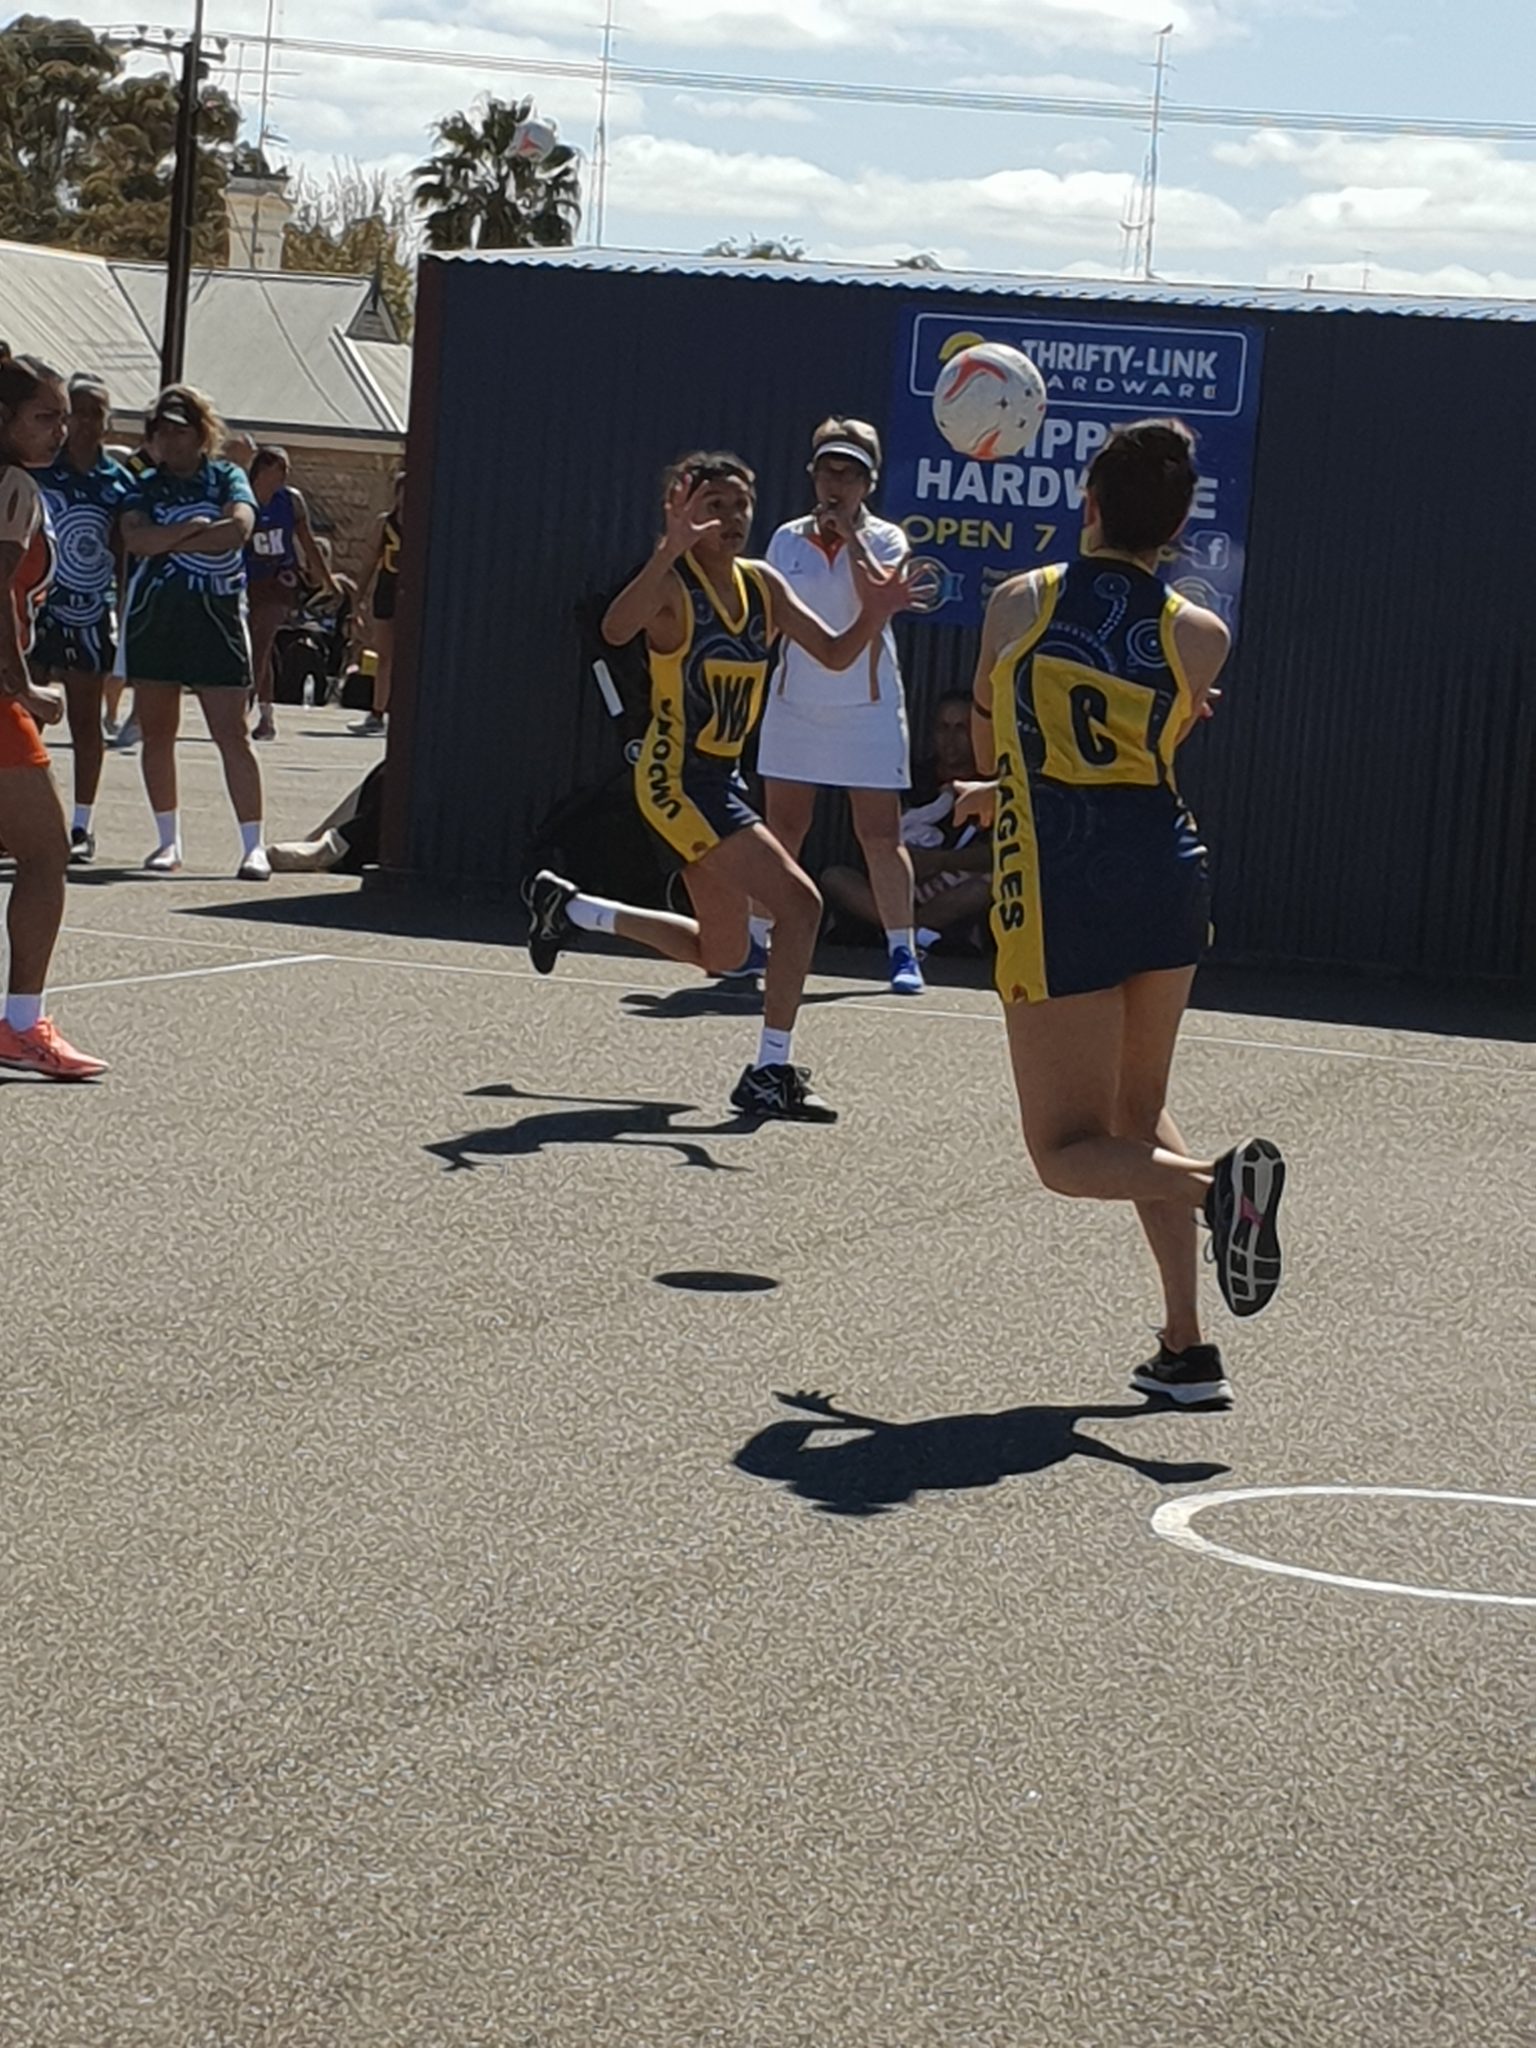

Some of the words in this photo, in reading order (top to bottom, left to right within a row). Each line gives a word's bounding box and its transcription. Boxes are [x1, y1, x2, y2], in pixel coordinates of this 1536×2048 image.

[1021, 339, 1218, 380] THRIFTY-LINK
[1047, 374, 1216, 400] ARDWARE
[902, 514, 1013, 550] OPEN
[1034, 524, 1057, 551] 7
[1069, 684, 1118, 766] C
[996, 752, 1025, 932] EAGLES
